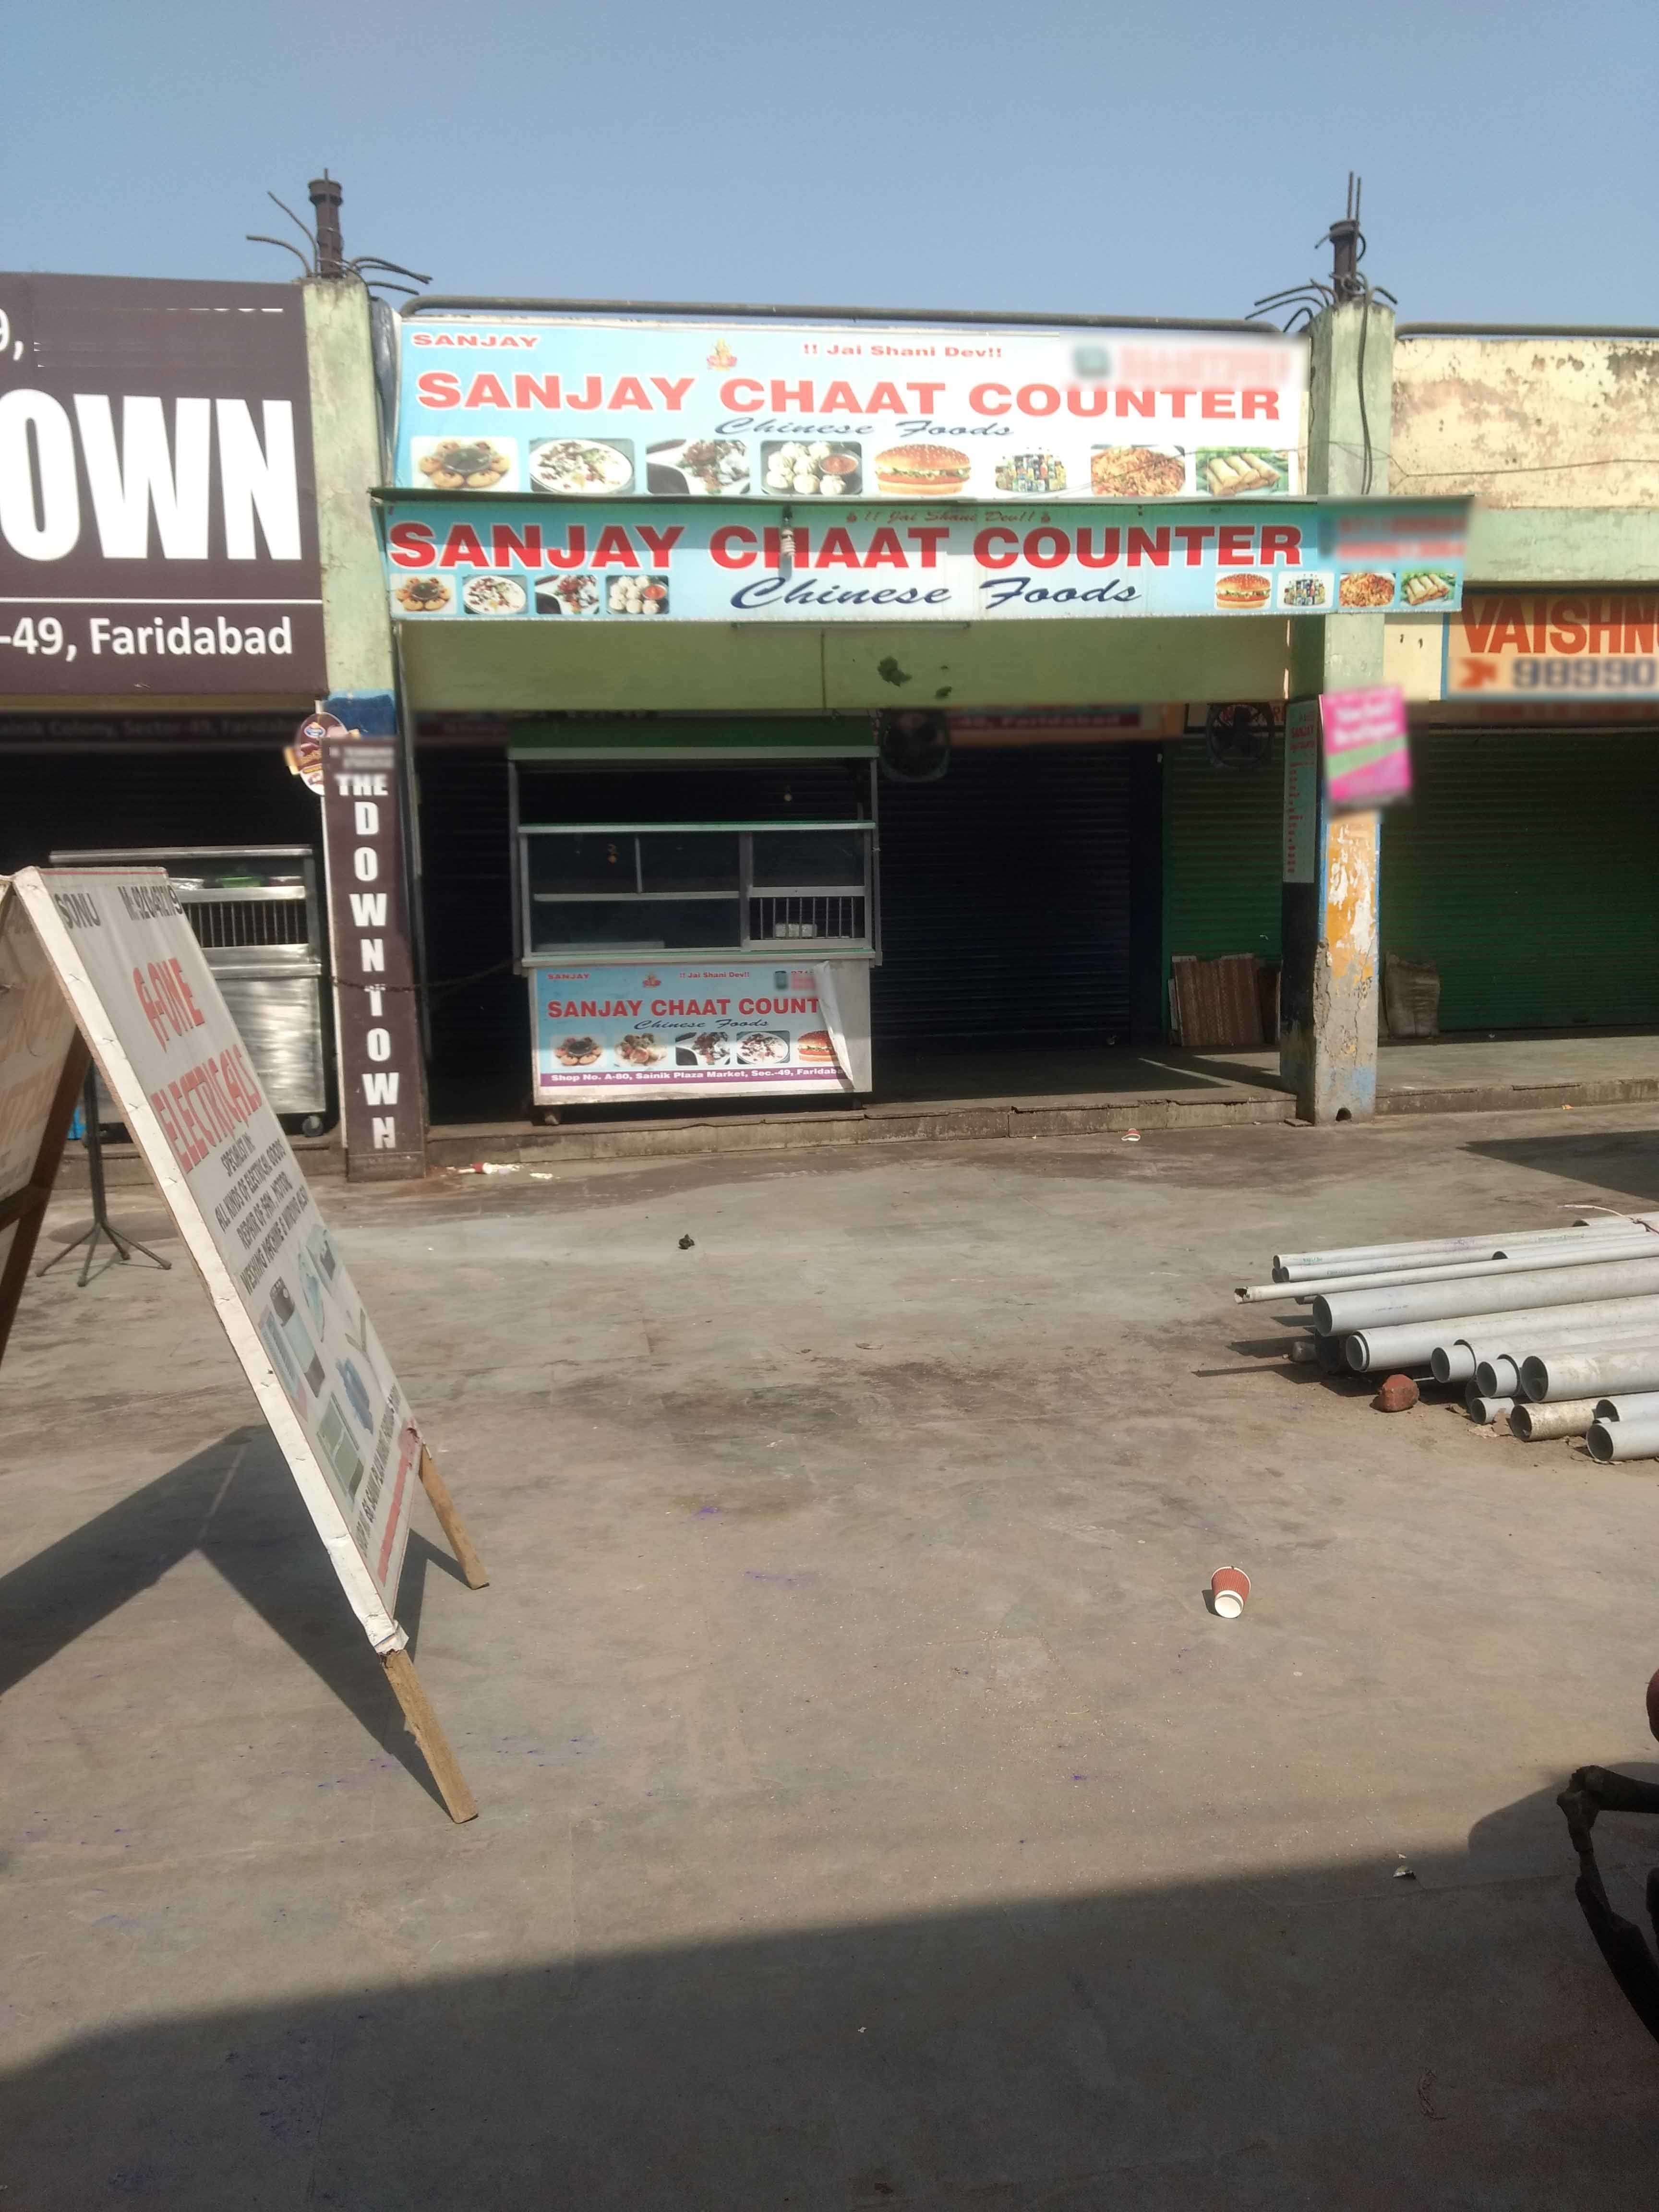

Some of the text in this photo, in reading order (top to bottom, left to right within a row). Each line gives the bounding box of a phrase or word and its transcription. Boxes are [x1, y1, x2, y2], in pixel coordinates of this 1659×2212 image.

[412, 334, 538, 348] SANJAY
[827, 344, 861, 356] Jai
[871, 345, 935, 357] Shani
[417, 372, 1280, 420] SANJAY CHAAT COUNTER
[715, 417, 1014, 437] Chinese Foods
[389, 522, 685, 568] SANJAY
[709, 525, 950, 568] CHAAT
[974, 526, 1302, 569] COUNTER
[730, 577, 1142, 610] Chinese Foods
[90, 616, 293, 656] Faridabad
[1462, 598, 1659, 654] VAISHN
[54, 893, 101, 928] SONU
[132, 957, 205, 1054] A-ONE
[548, 998, 818, 1018] SANJAY CHAAT COUNT
[634, 1019, 769, 1030] Chinese Foods
[552, 1074, 580, 1082] Shop
[150, 1044, 262, 1175] ELECTRICALS
